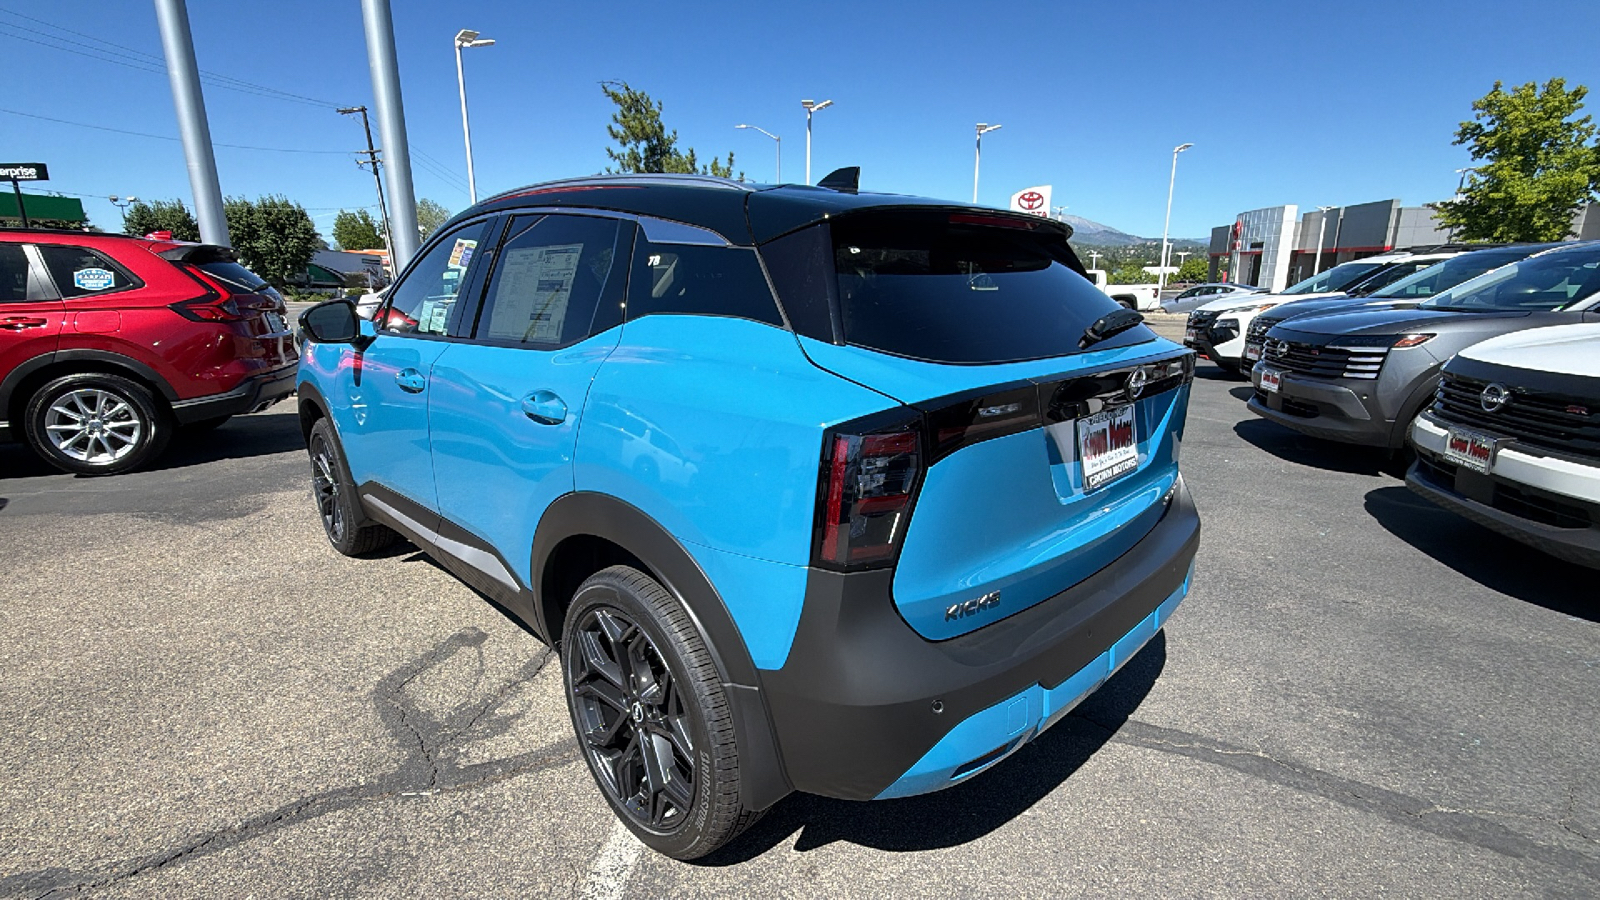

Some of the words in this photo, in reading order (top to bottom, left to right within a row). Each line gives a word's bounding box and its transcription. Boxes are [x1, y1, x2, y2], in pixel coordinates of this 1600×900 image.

[1089, 470, 1112, 486] CROWN
[1112, 458, 1137, 475] MOTORS
[945, 590, 1000, 618] KICKS
